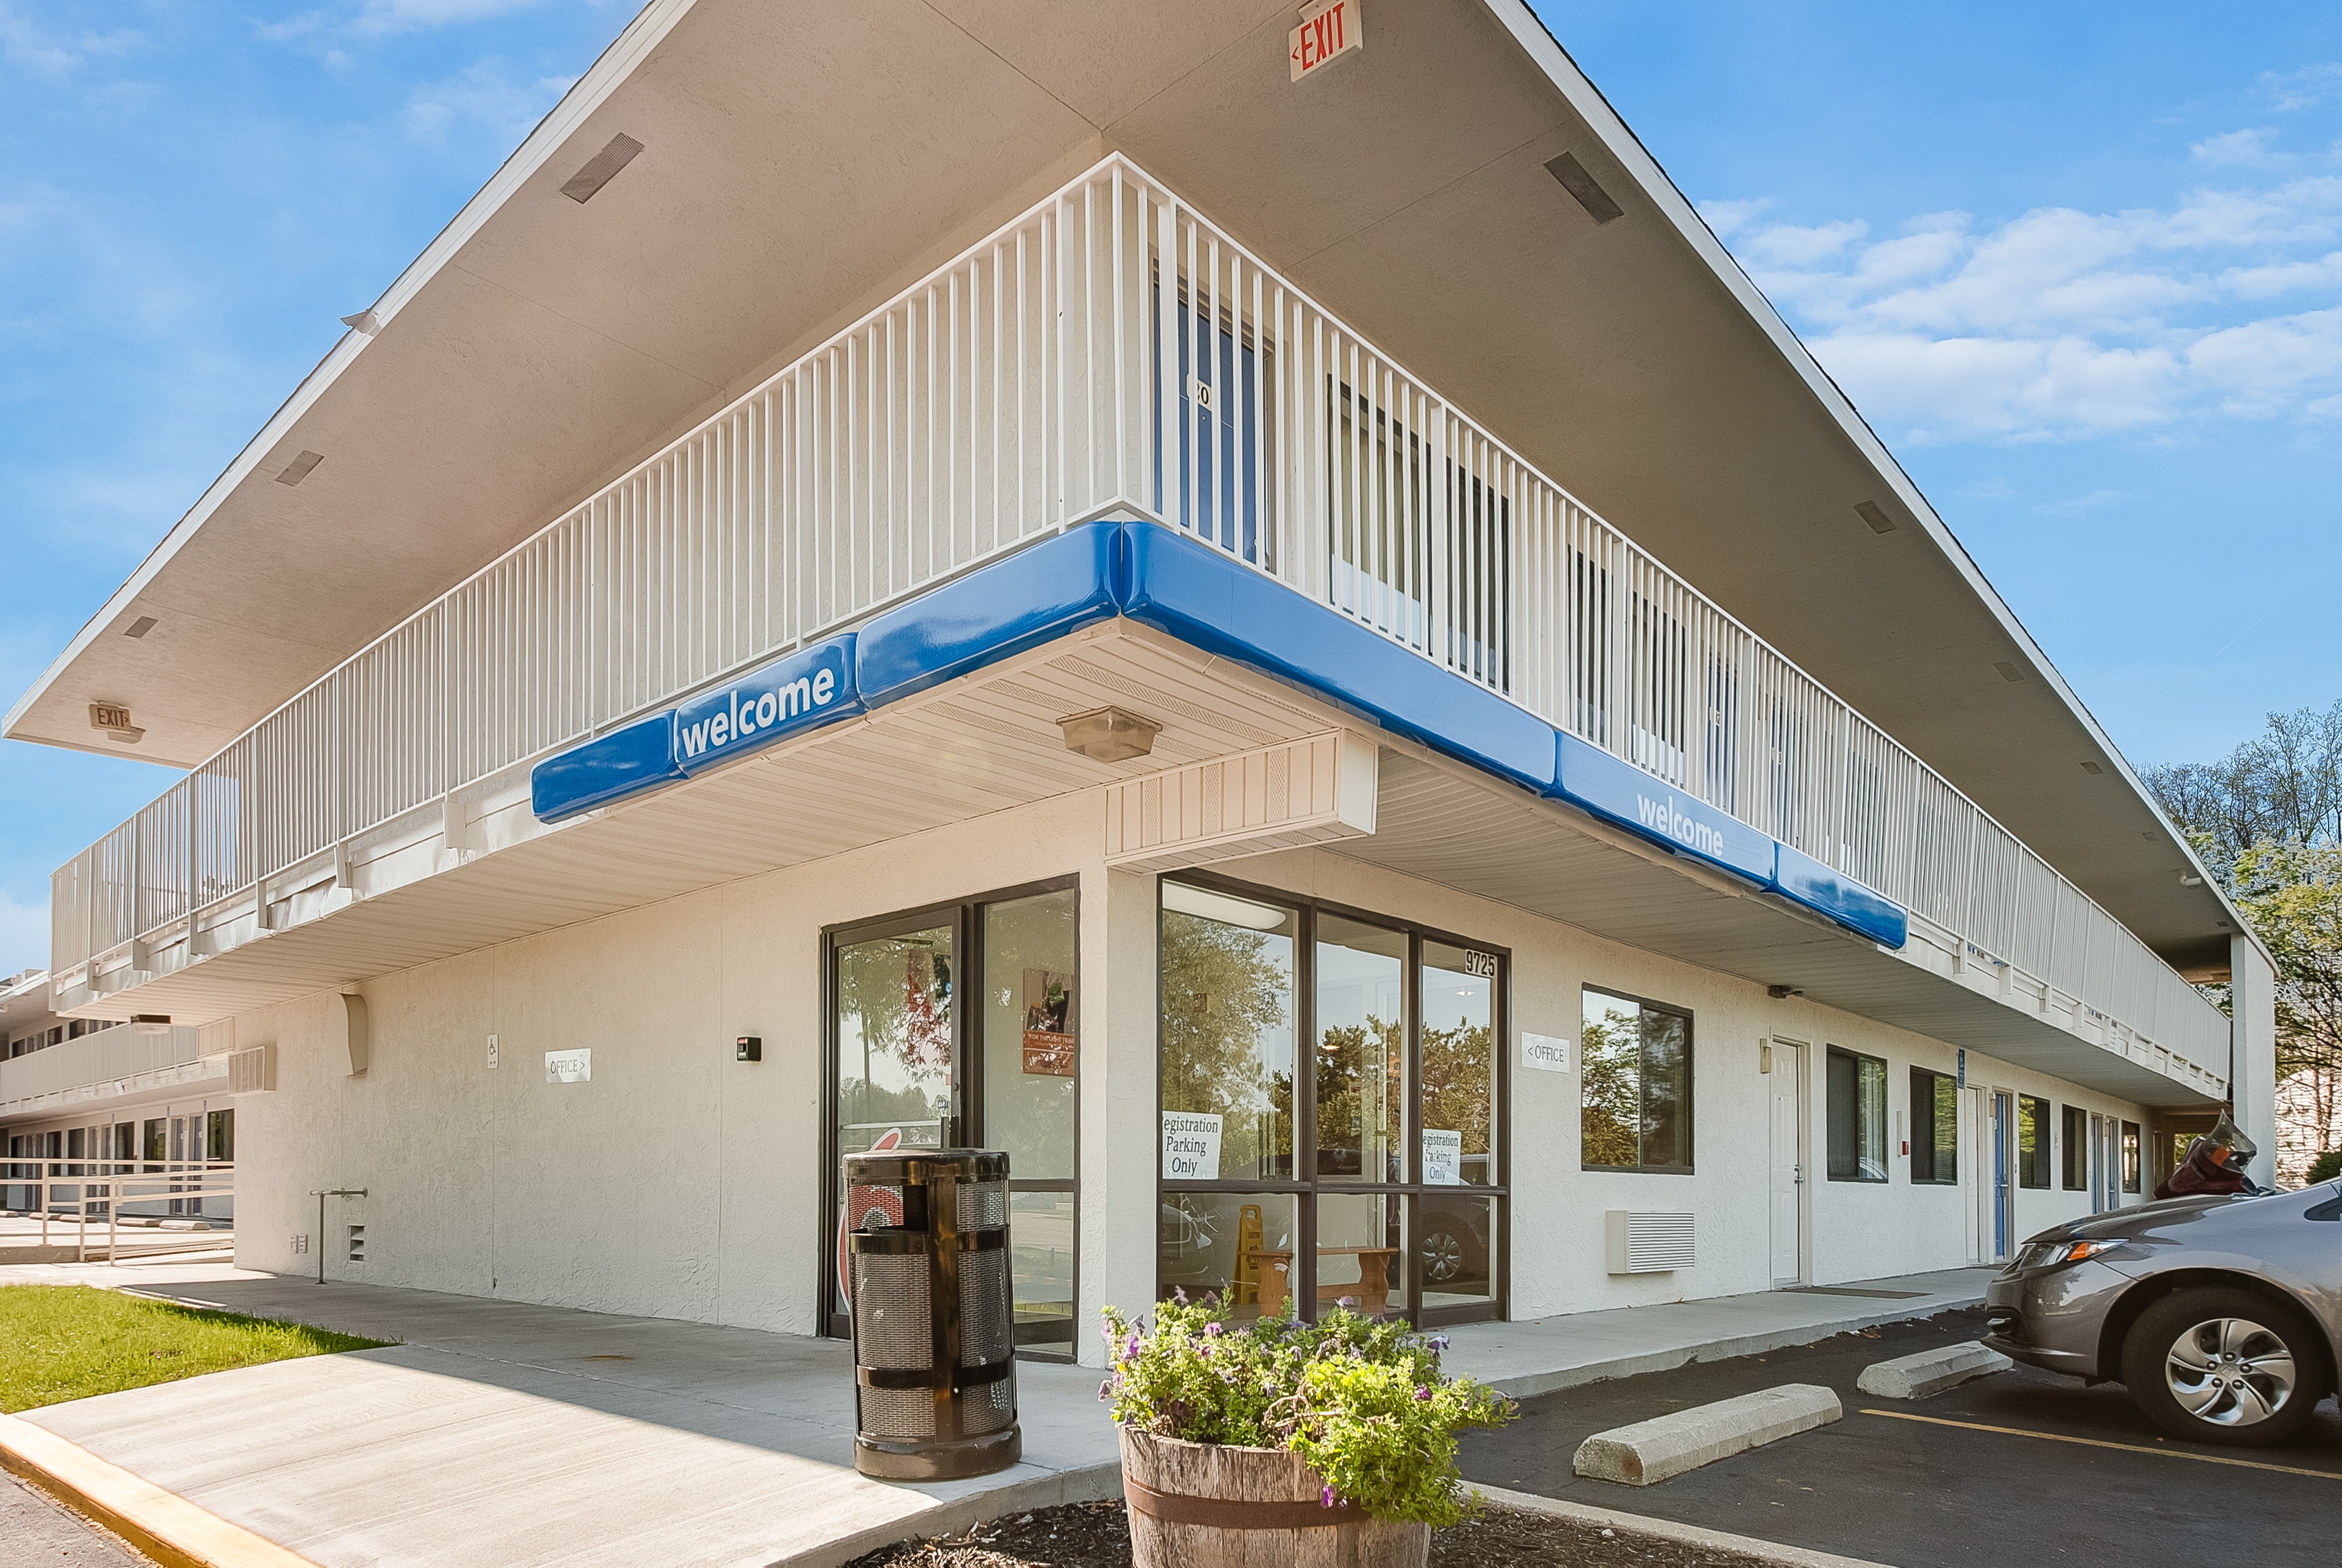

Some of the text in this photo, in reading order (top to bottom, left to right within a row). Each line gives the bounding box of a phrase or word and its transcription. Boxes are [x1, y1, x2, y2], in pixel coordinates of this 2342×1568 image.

[1300, 1, 1345, 71] EXIT
[97, 707, 125, 727] EXIT
[681, 668, 835, 758] welcome
[1637, 794, 1723, 856] welcome
[1466, 950, 1495, 976] 9725
[1534, 1045, 1564, 1063] OFFICE
[550, 1059, 578, 1074] OFFICE
[1163, 1115, 1219, 1135] egistration
[1165, 1136, 1207, 1157] Parking
[1423, 1133, 1458, 1149] egistration
[1171, 1157, 1198, 1177] Only
[1429, 1166, 1447, 1182] Only
